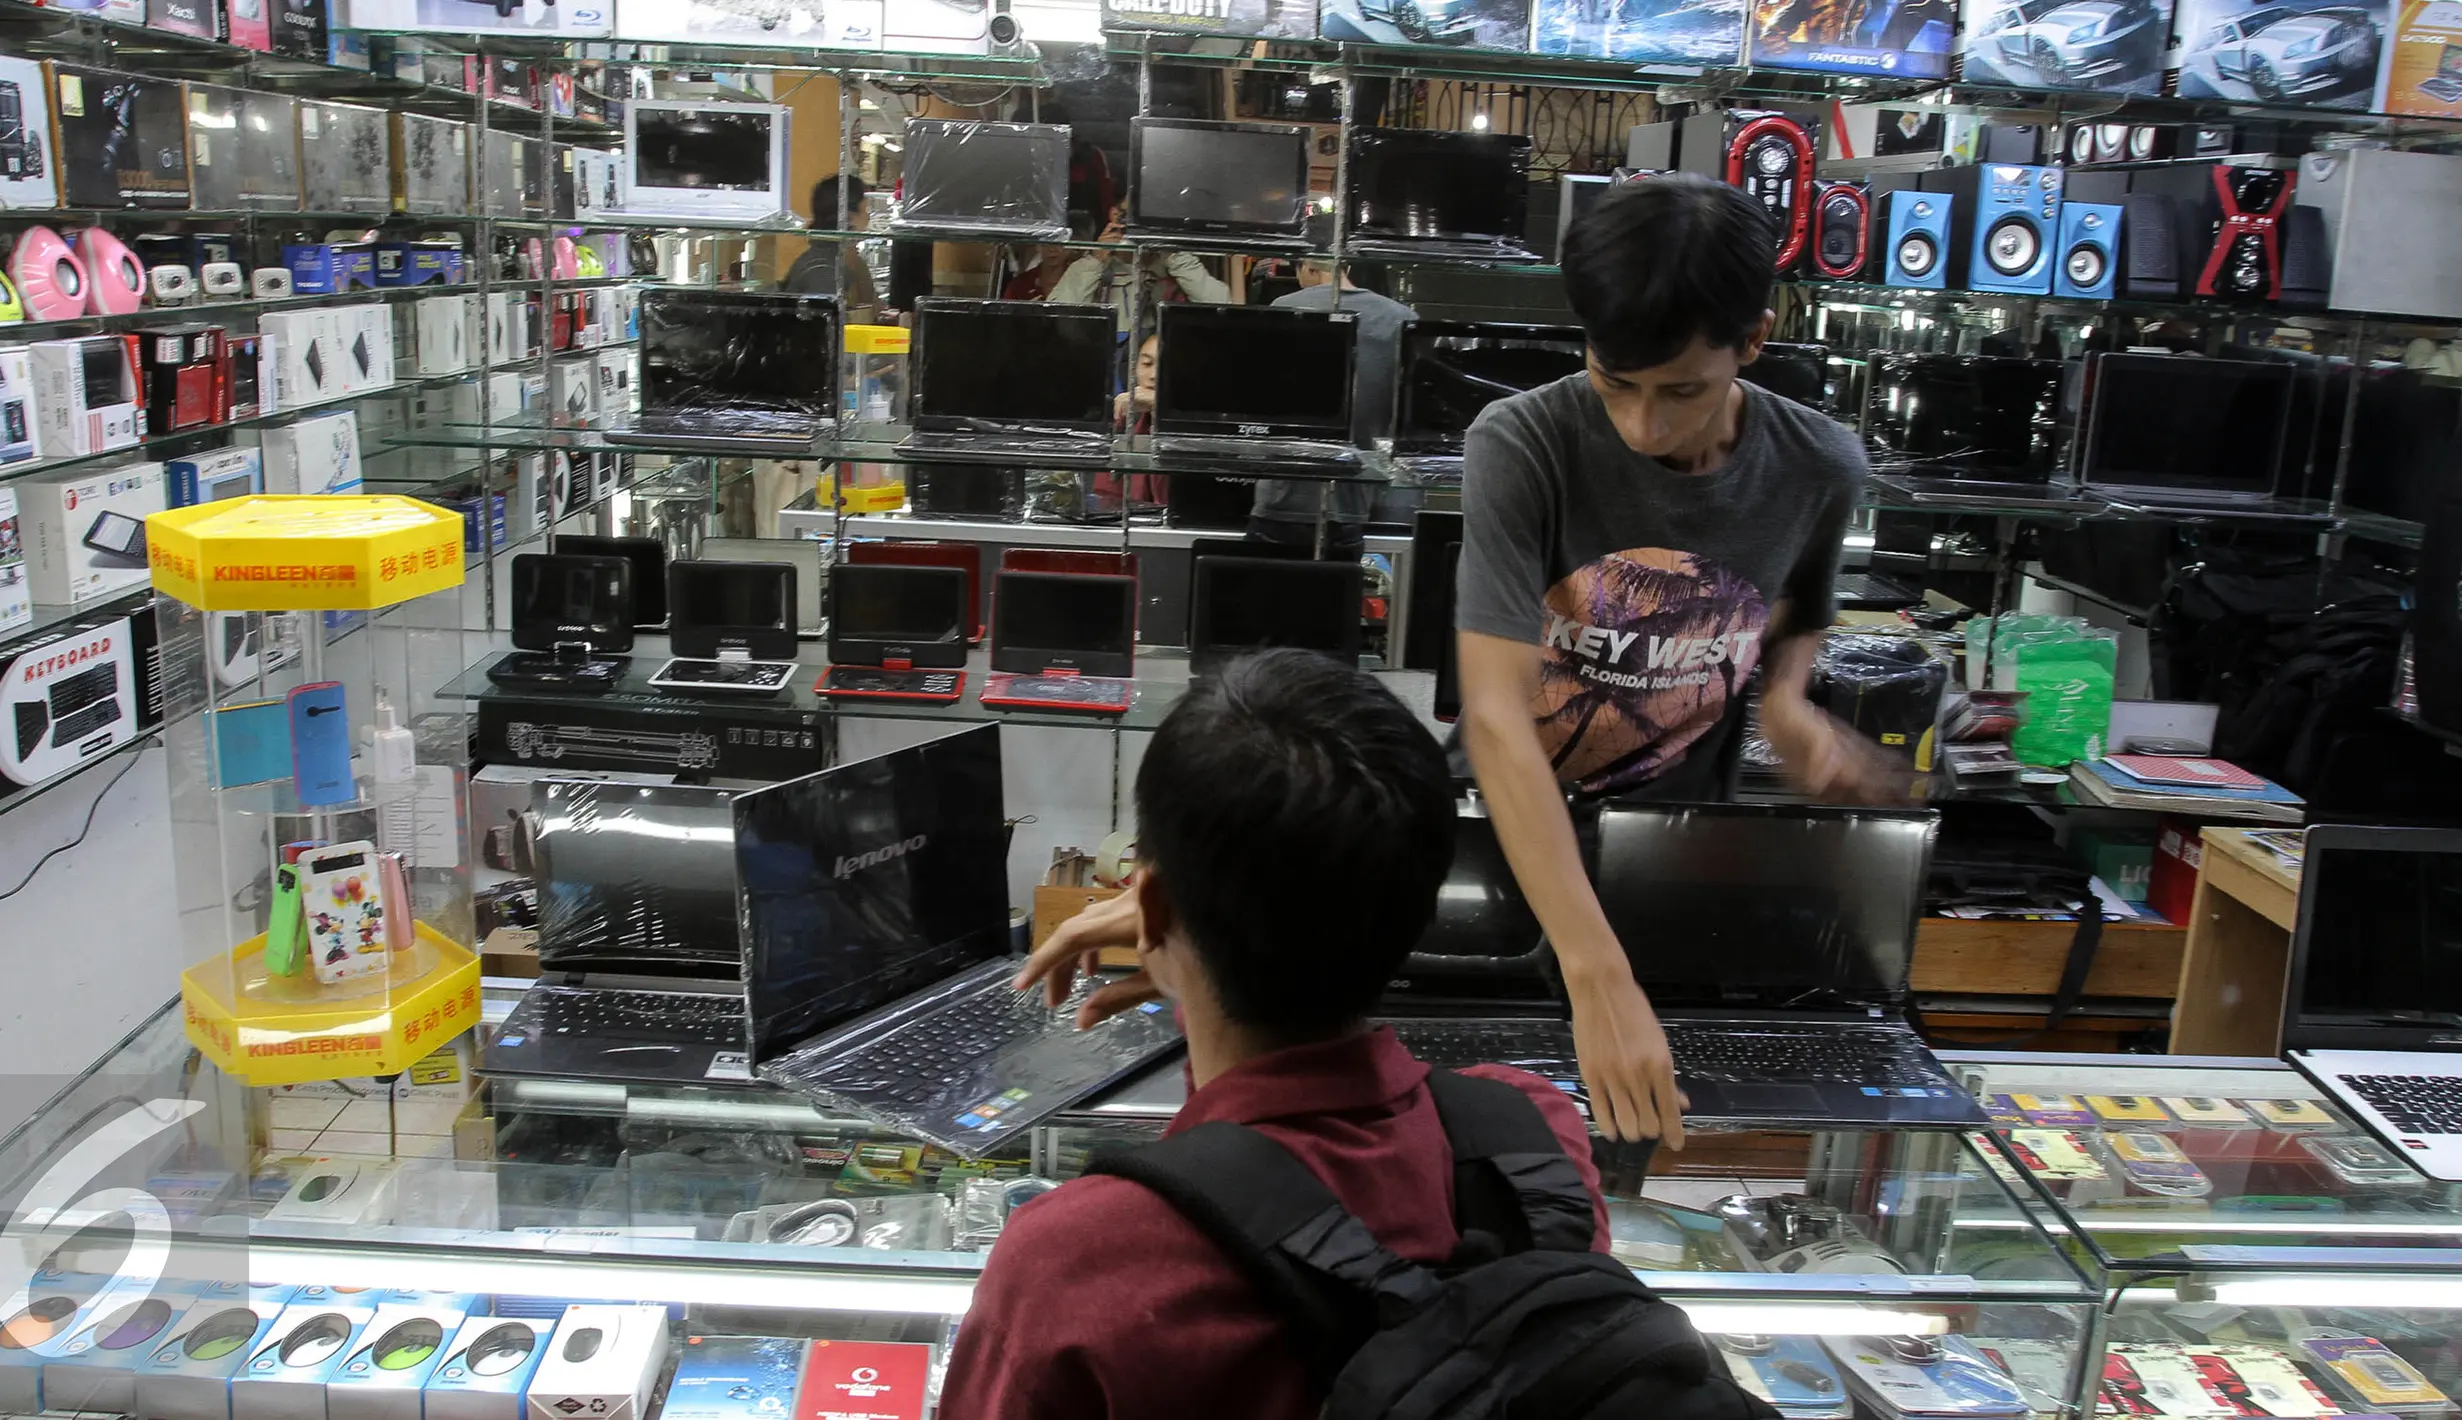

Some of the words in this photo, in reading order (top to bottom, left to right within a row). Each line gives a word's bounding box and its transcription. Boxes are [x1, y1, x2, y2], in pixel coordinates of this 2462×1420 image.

[1808, 51, 1880, 66] FANTASTIC
[213, 565, 316, 582] KINGLEEN
[380, 540, 458, 582] 移动电源
[1546, 613, 1640, 665] KEY
[1646, 630, 1758, 670] WEST
[24, 637, 112, 683] KEYBOARD
[1579, 664, 1648, 689] FLORIDA
[1650, 671, 1710, 690] ISLANDS
[834, 833, 927, 879] lenovo
[404, 985, 476, 1045] 移动电源
[249, 1035, 348, 1058] KINGLEEN
[834, 1382, 892, 1392] vodafone
